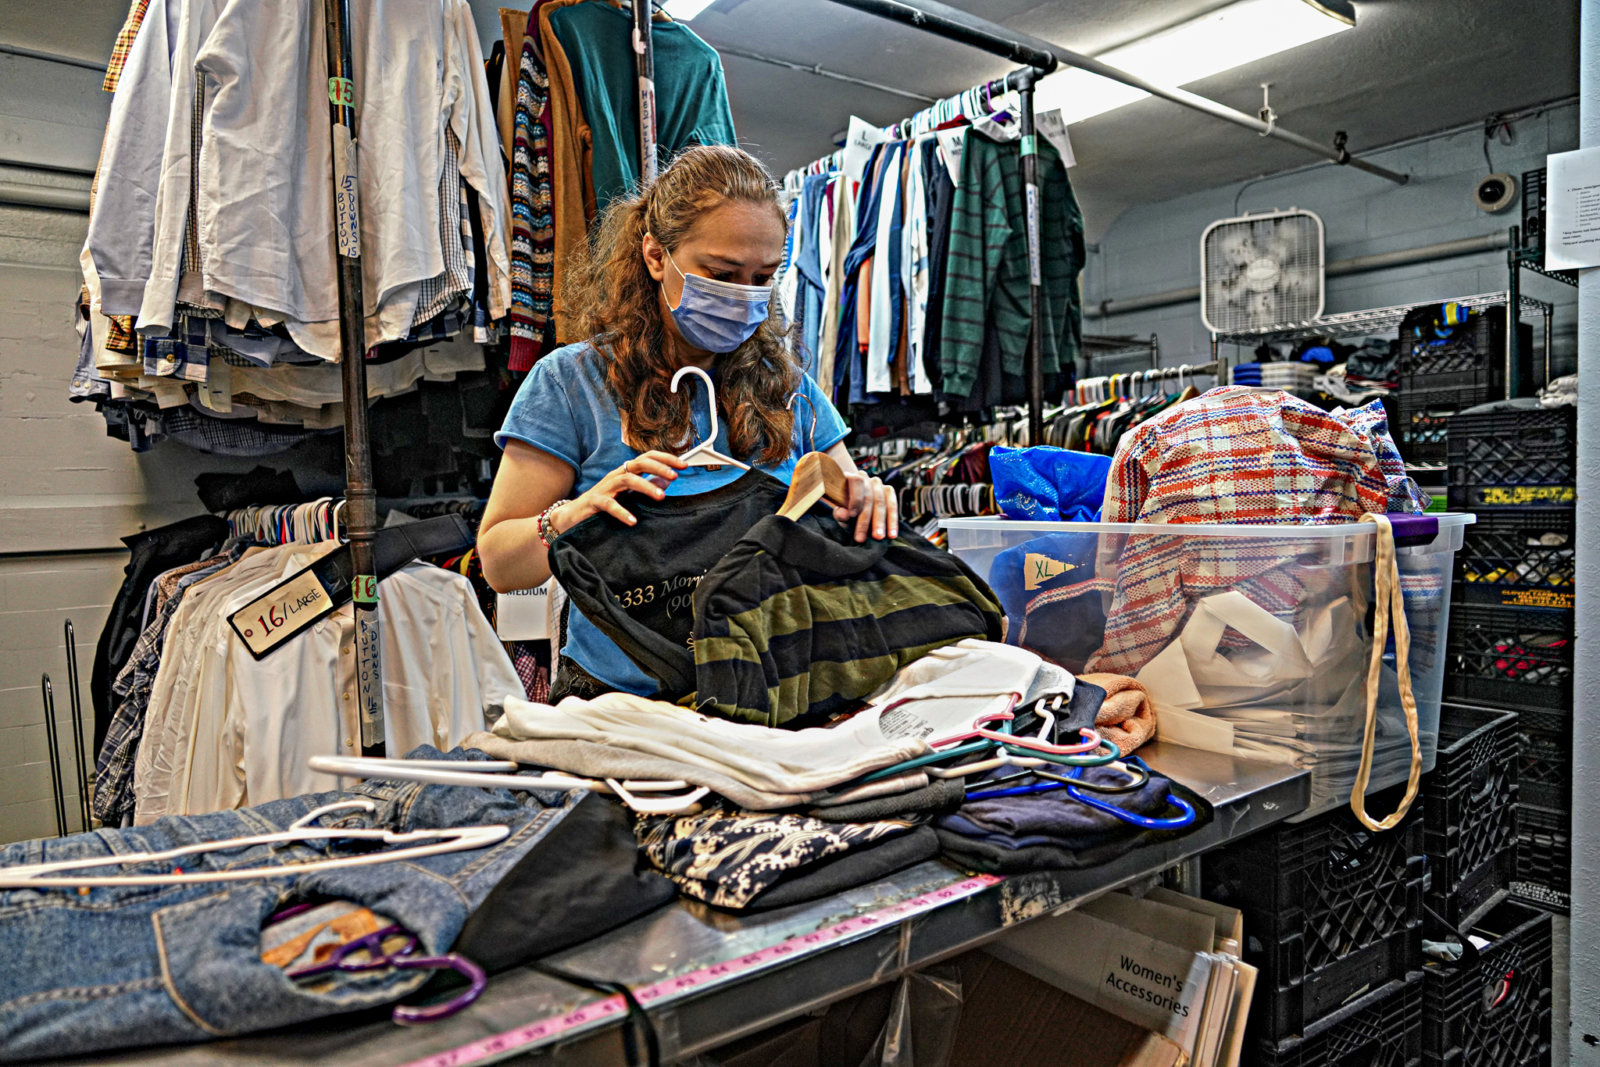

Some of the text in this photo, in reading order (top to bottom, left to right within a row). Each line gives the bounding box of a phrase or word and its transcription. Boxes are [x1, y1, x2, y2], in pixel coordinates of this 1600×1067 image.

[335, 80, 353, 103] 15
[337, 193, 349, 247] BUTTON
[1035, 560, 1055, 579] XL
[354, 576, 377, 599] 16
[506, 587, 548, 596] MEDIUM
[1120, 954, 1184, 992] Women's
[1105, 972, 1190, 1017] Accessories
